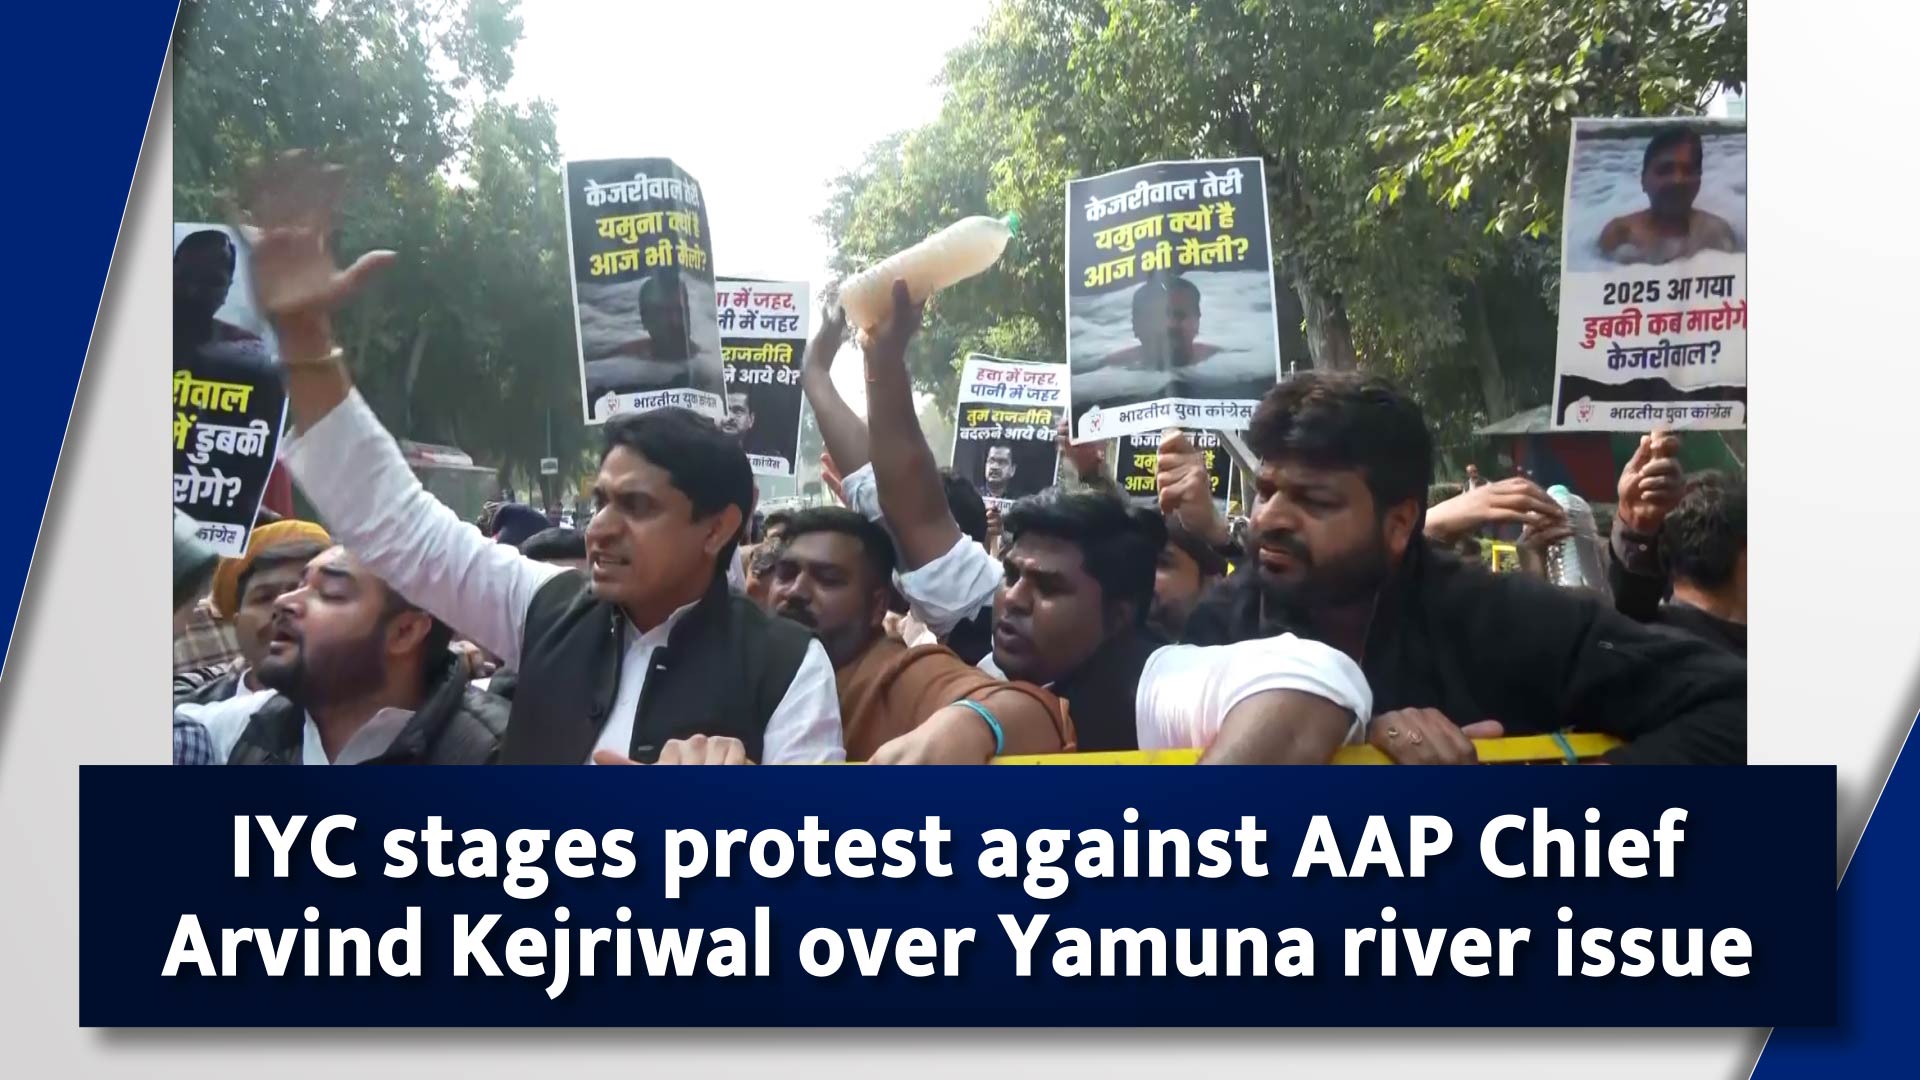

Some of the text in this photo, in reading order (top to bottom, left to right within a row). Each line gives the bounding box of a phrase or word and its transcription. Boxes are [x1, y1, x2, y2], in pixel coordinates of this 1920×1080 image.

[583, 172, 682, 207] केजरीवाल
[1085, 167, 1244, 222] केजरीवाल तेरी
[595, 211, 664, 244] यमुना
[1094, 201, 1236, 252] यमुना क्यों है
[589, 248, 640, 276] आज
[644, 238, 673, 267] भी
[1084, 234, 1249, 289] आज भी मैली?
[733, 287, 752, 308] में
[753, 291, 796, 312] जहर,
[1603, 275, 1735, 305] 2025 आ गया
[718, 308, 799, 333] नी में जहर
[1580, 300, 1747, 349] डुबकी कब मारोगे
[721, 342, 793, 364] राजनीति
[1607, 339, 1721, 371] केजरीवाल?
[739, 364, 774, 384] आये
[976, 366, 1004, 382] हवा
[1006, 368, 1023, 383] में
[173, 369, 255, 413] ीवाल
[634, 391, 680, 409] भारतीय
[971, 382, 1061, 402] पानी में जहर
[966, 408, 990, 427] तुम
[1119, 402, 1252, 423] भारतीय युवा कांग्रेस
[1610, 404, 1733, 423] भारतीय युवा कांग्रेस
[186, 419, 270, 464] डुबकी
[1133, 453, 1158, 474] यमु
[173, 465, 242, 507] रोगे?
[1124, 475, 1155, 491] आज
